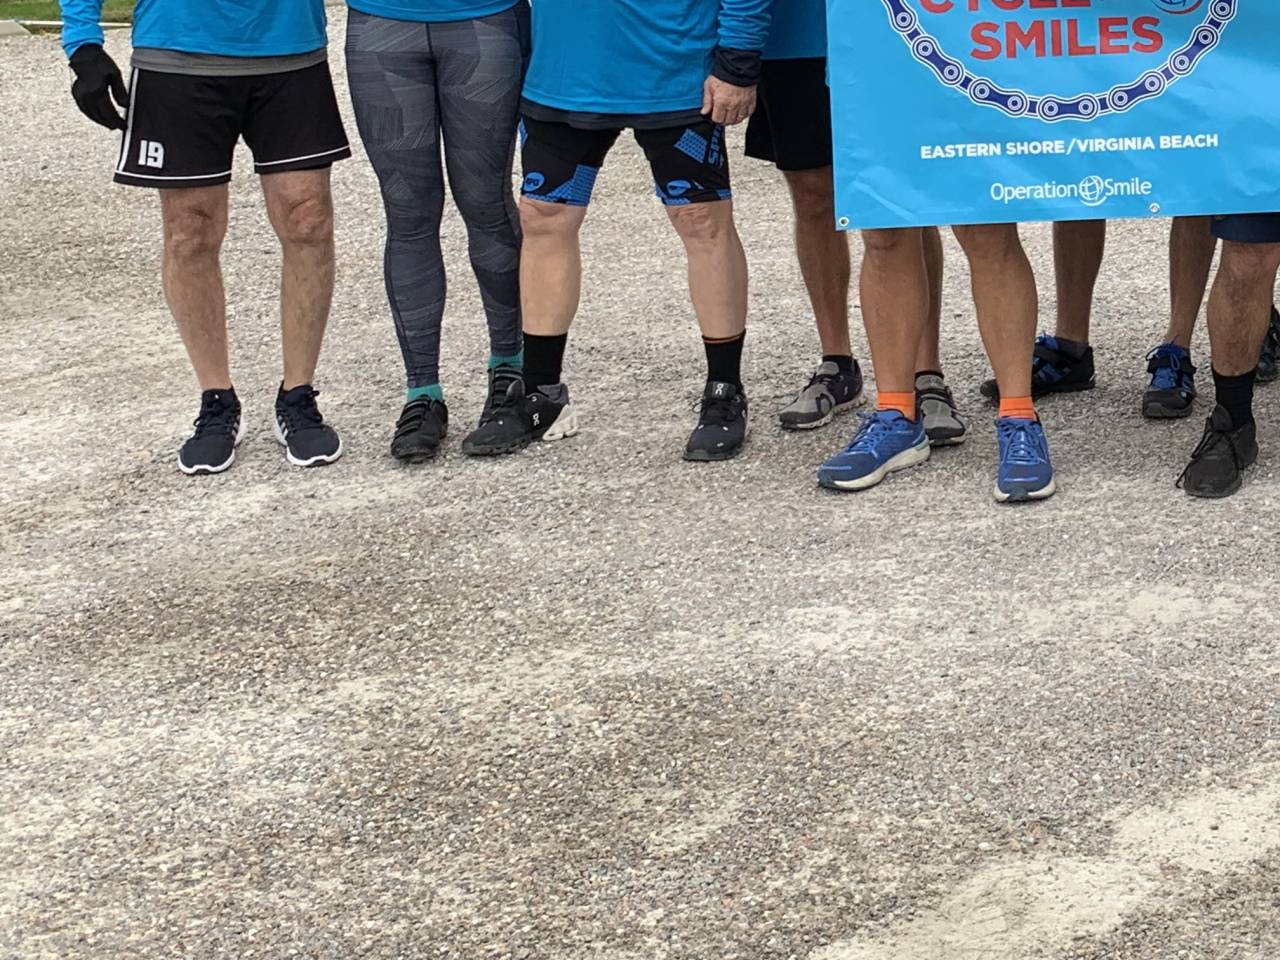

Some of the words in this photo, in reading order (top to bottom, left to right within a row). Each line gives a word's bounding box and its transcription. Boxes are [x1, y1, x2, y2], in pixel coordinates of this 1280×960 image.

[970, 15, 1164, 60] SMILES
[138, 140, 164, 169] 19
[920, 143, 1001, 159] EASTERN
[1006, 138, 1155, 156] SHORE/VIRGINIA
[1160, 134, 1218, 150] BEACH
[990, 180, 1078, 204] Operation
[1104, 176, 1152, 196] Smile
